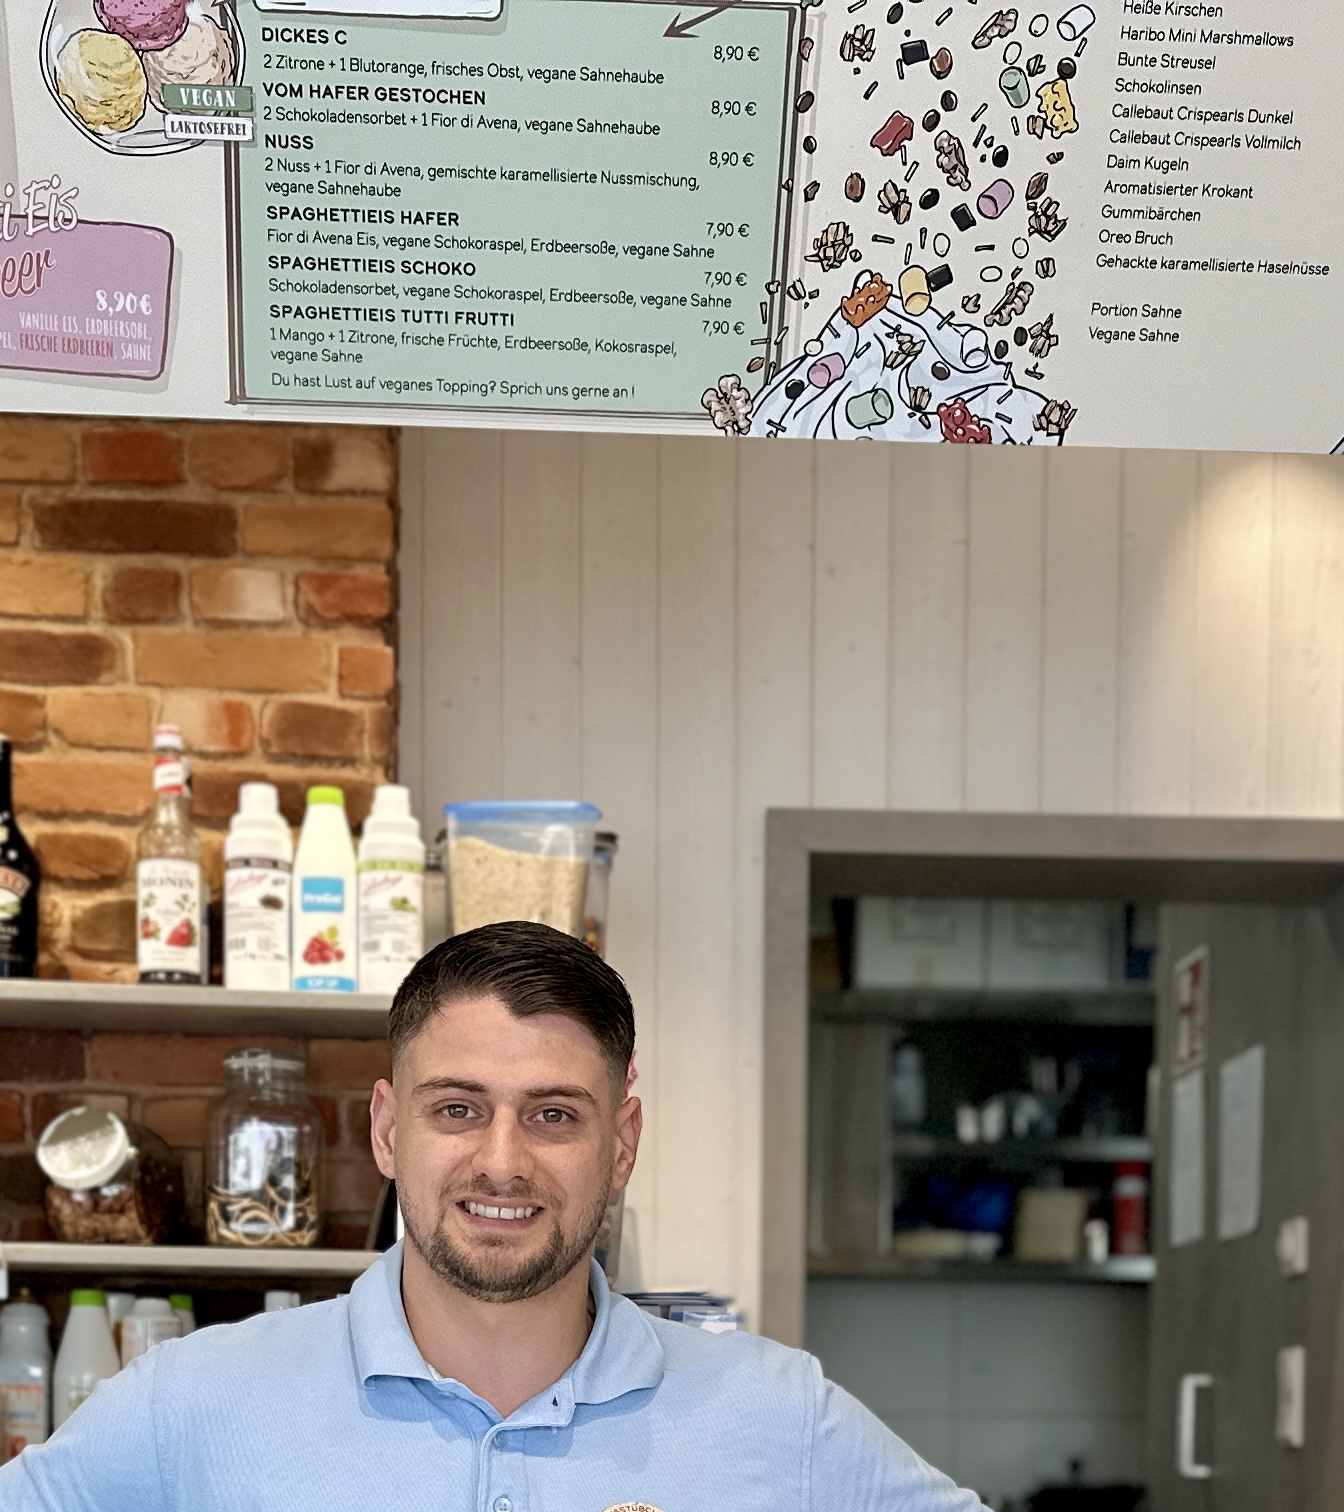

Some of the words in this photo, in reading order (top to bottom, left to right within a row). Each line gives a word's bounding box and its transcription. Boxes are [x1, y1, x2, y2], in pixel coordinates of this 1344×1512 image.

[261, 26, 329, 45] DICKES
[334, 29, 348, 46] C
[1120, 25, 1166, 42] Haribo
[1168, 27, 1197, 43] Mini
[1199, 28, 1294, 47] Marshmallows
[713, 45, 744, 64] 8,90
[747, 46, 760, 62] €
[1117, 51, 1158, 68] Bunte
[1160, 53, 1217, 70] Streusel
[181, 87, 237, 109] VEGAN
[262, 81, 303, 99] VOM
[309, 83, 370, 101] HAFER
[374, 86, 486, 106] GESTOCHEN
[169, 118, 249, 139] LAKTOSEFREI
[264, 133, 314, 150] NUSS
[23, 174, 80, 237] Eis
[1101, 203, 1201, 222] Gummibärchen
[266, 205, 395, 225] SPAGHETTIEIS
[400, 210, 460, 227] HAFER
[706, 222, 734, 240] 7,90
[737, 223, 750, 238] €
[1098, 228, 1132, 244] Oreo
[1134, 230, 1174, 246] Bruch
[95, 289, 153, 317] 8,90€
[1090, 302, 1138, 317] Portion
[1141, 303, 1182, 319] Sahne
[269, 304, 396, 323] SPAGHETTIEIS
[400, 309, 449, 325] TUTTI
[454, 311, 514, 327] FRUTTI
[1088, 326, 1136, 344] Vegane
[1138, 327, 1180, 343] Sahne
[270, 350, 319, 369] vegane
[321, 348, 363, 364] Sahne
[142, 876, 195, 890] MONIN
